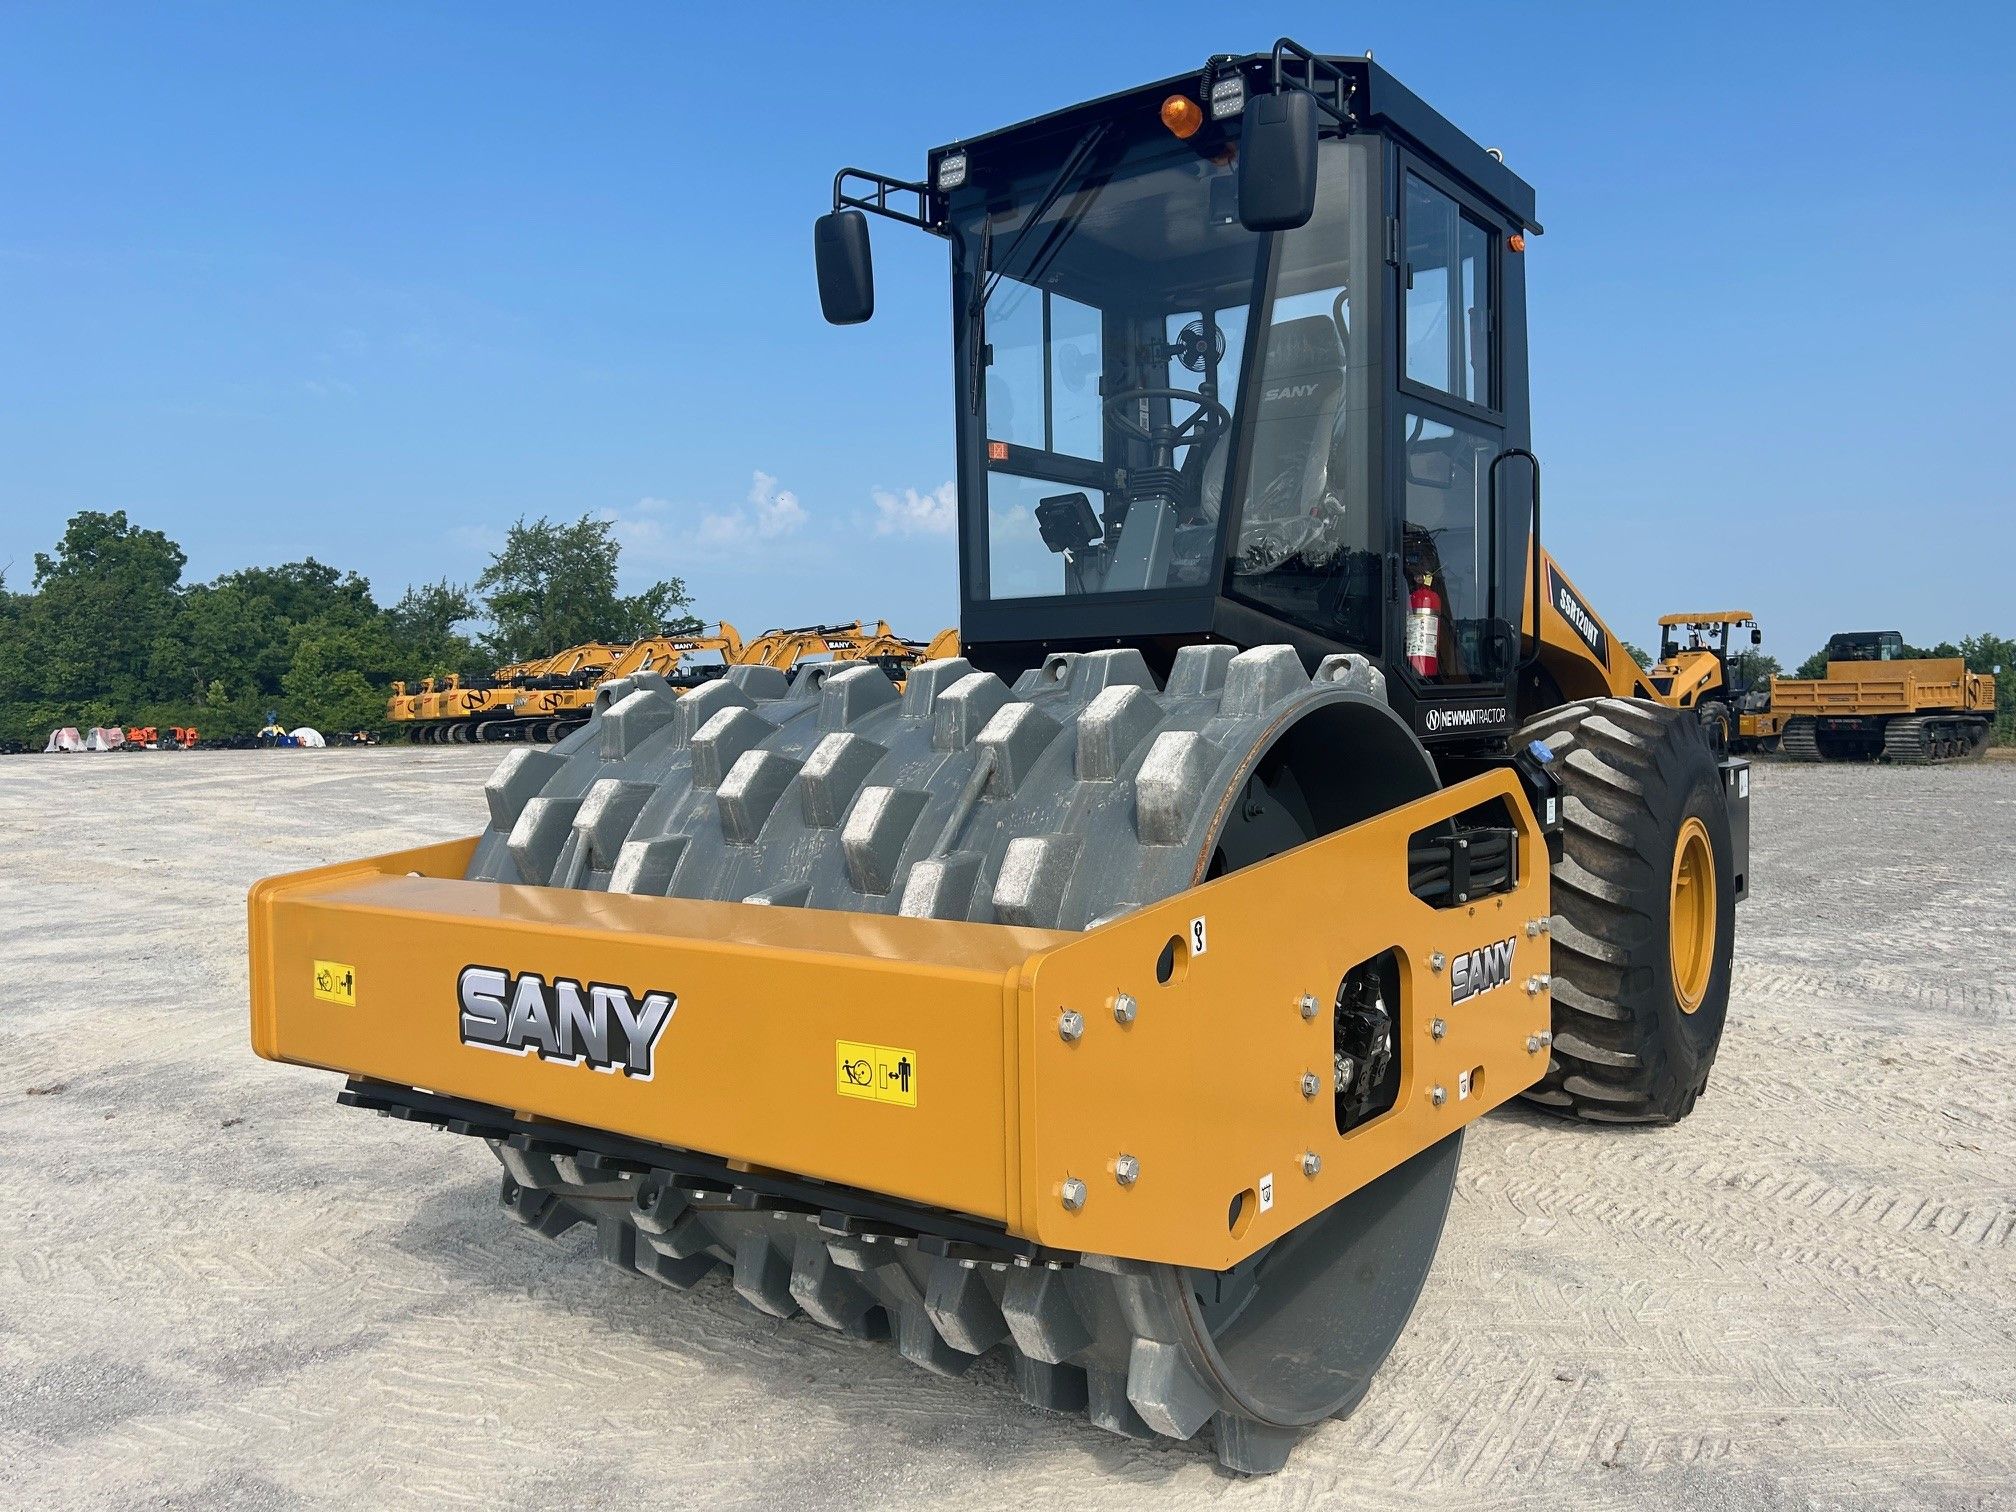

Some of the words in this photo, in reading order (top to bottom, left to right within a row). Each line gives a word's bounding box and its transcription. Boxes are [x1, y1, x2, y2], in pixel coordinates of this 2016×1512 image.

[1264, 384, 1318, 401] SANY
[829, 641, 849, 649] SANY
[1451, 935, 1517, 1007] SANY
[457, 964, 678, 1082] SANY
